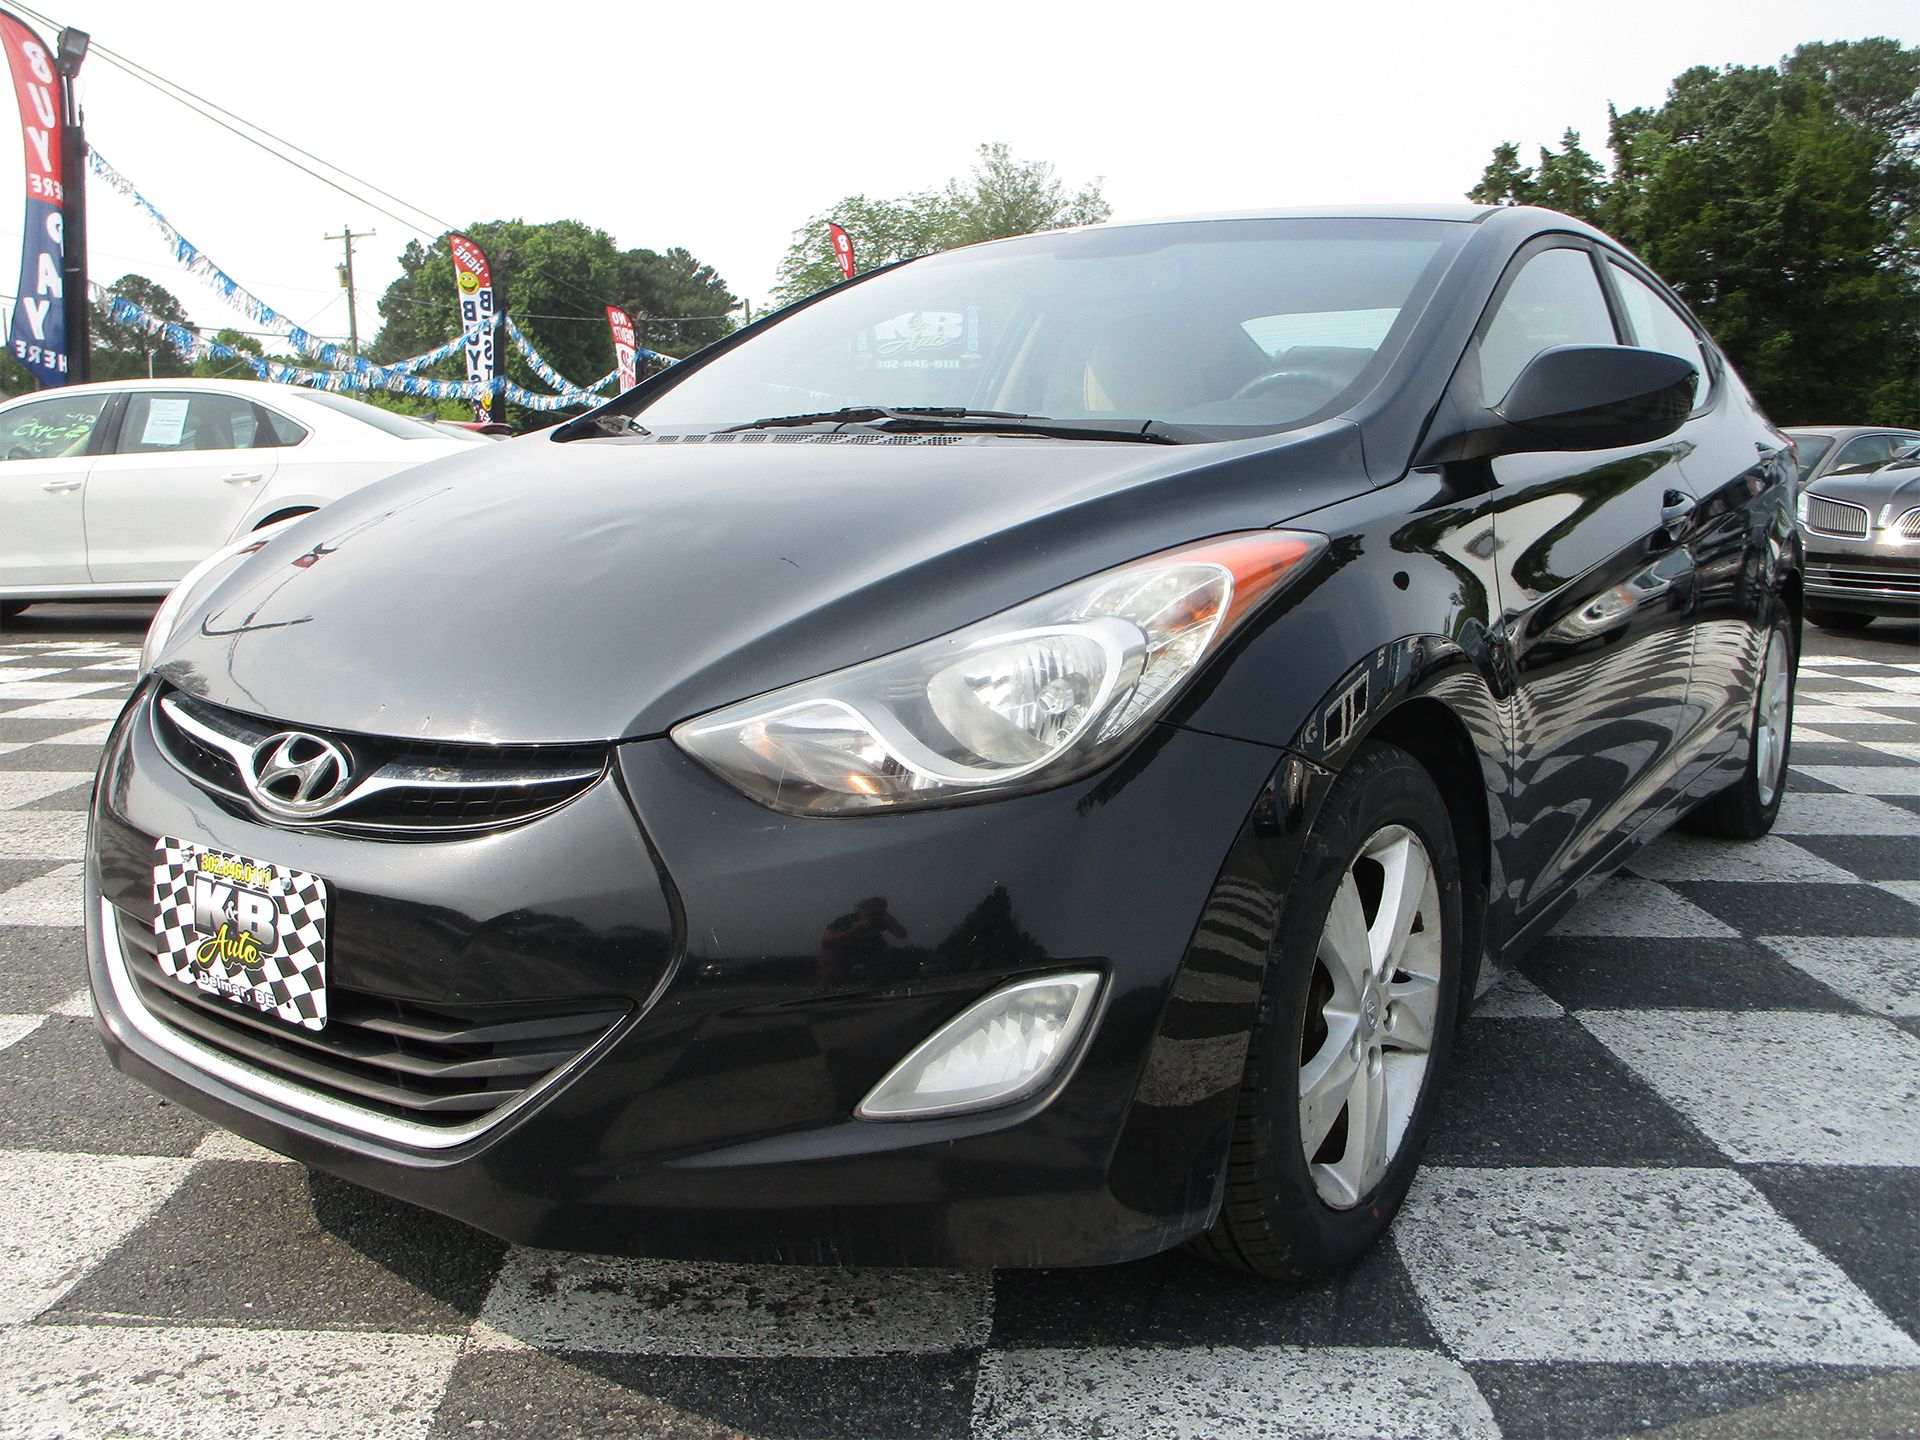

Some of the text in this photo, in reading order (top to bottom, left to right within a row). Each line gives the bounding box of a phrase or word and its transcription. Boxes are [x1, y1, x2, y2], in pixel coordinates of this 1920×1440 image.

[201, 854, 272, 889] 302.846.0111
[195, 877, 277, 947] K&B
[197, 923, 262, 964] Auto
[200, 972, 276, 1008] Delmar, DE
